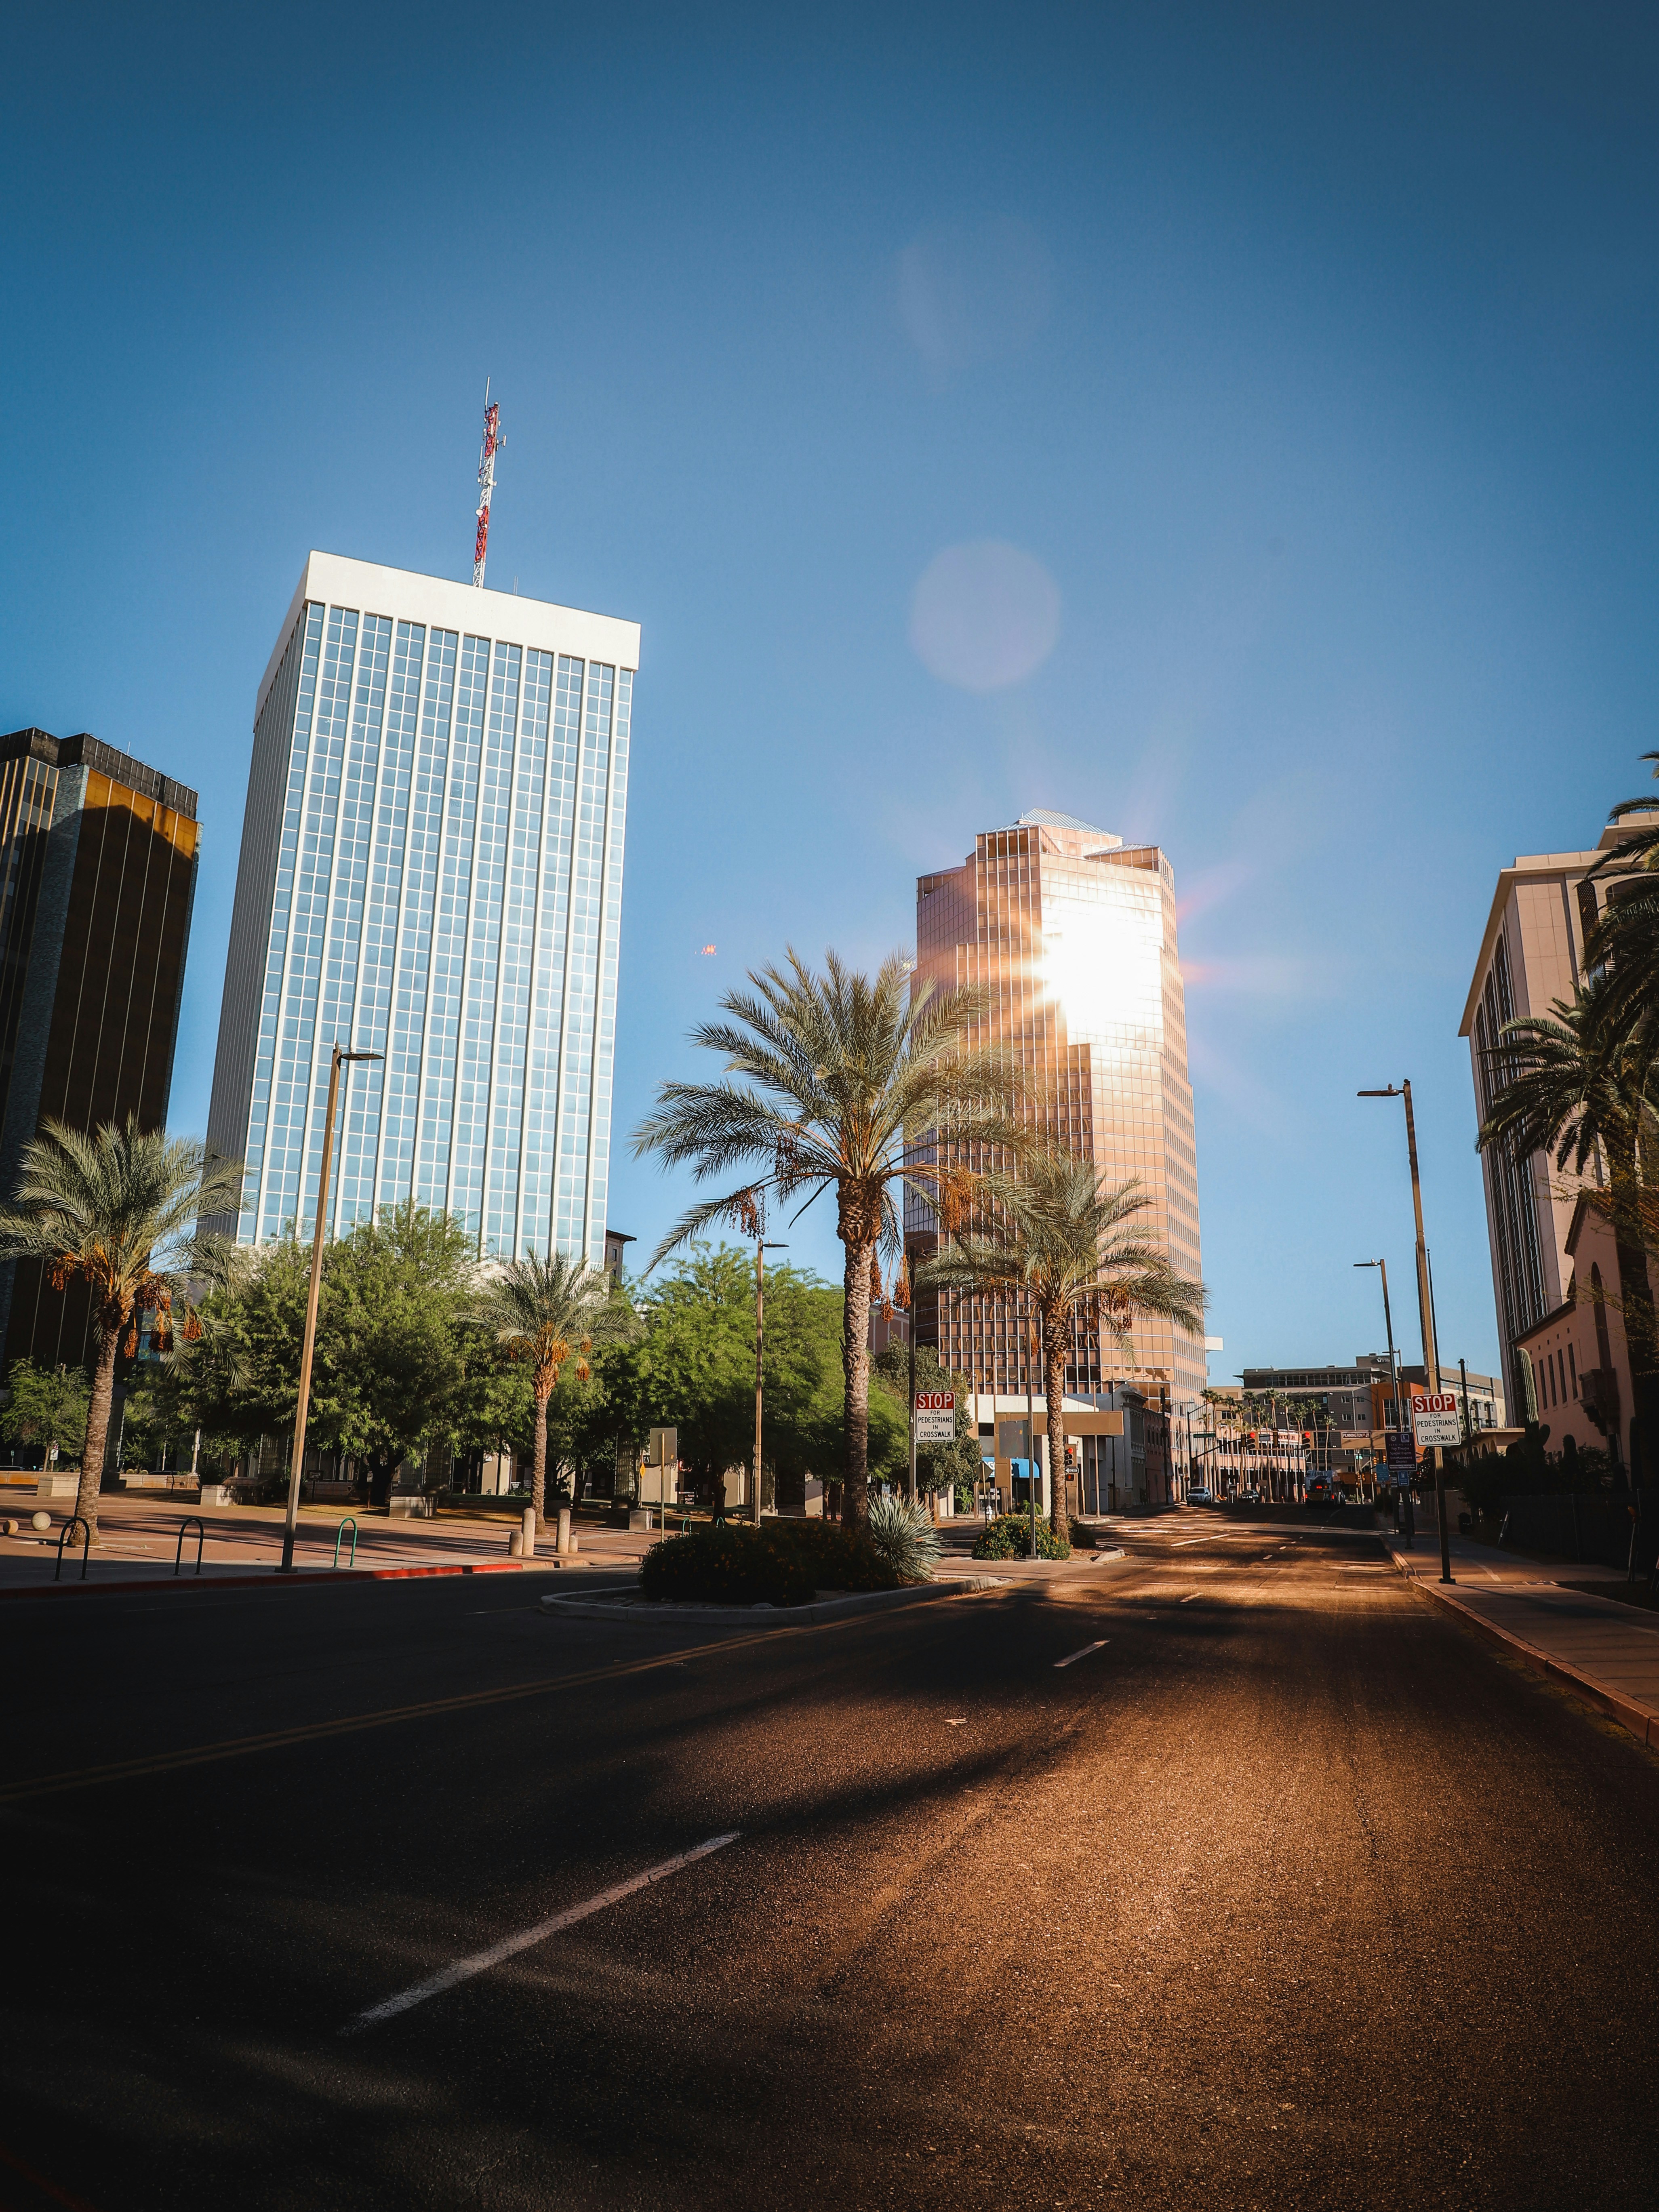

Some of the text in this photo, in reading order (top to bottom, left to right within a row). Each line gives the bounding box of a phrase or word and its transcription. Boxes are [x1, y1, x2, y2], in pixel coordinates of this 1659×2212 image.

[918, 1393, 952, 1408] STOP
[1415, 1395, 1453, 1412] STOP
[1417, 1419, 1456, 1427] PEDESTRIANS
[1421, 1434, 1456, 1442] CROSSWALK
